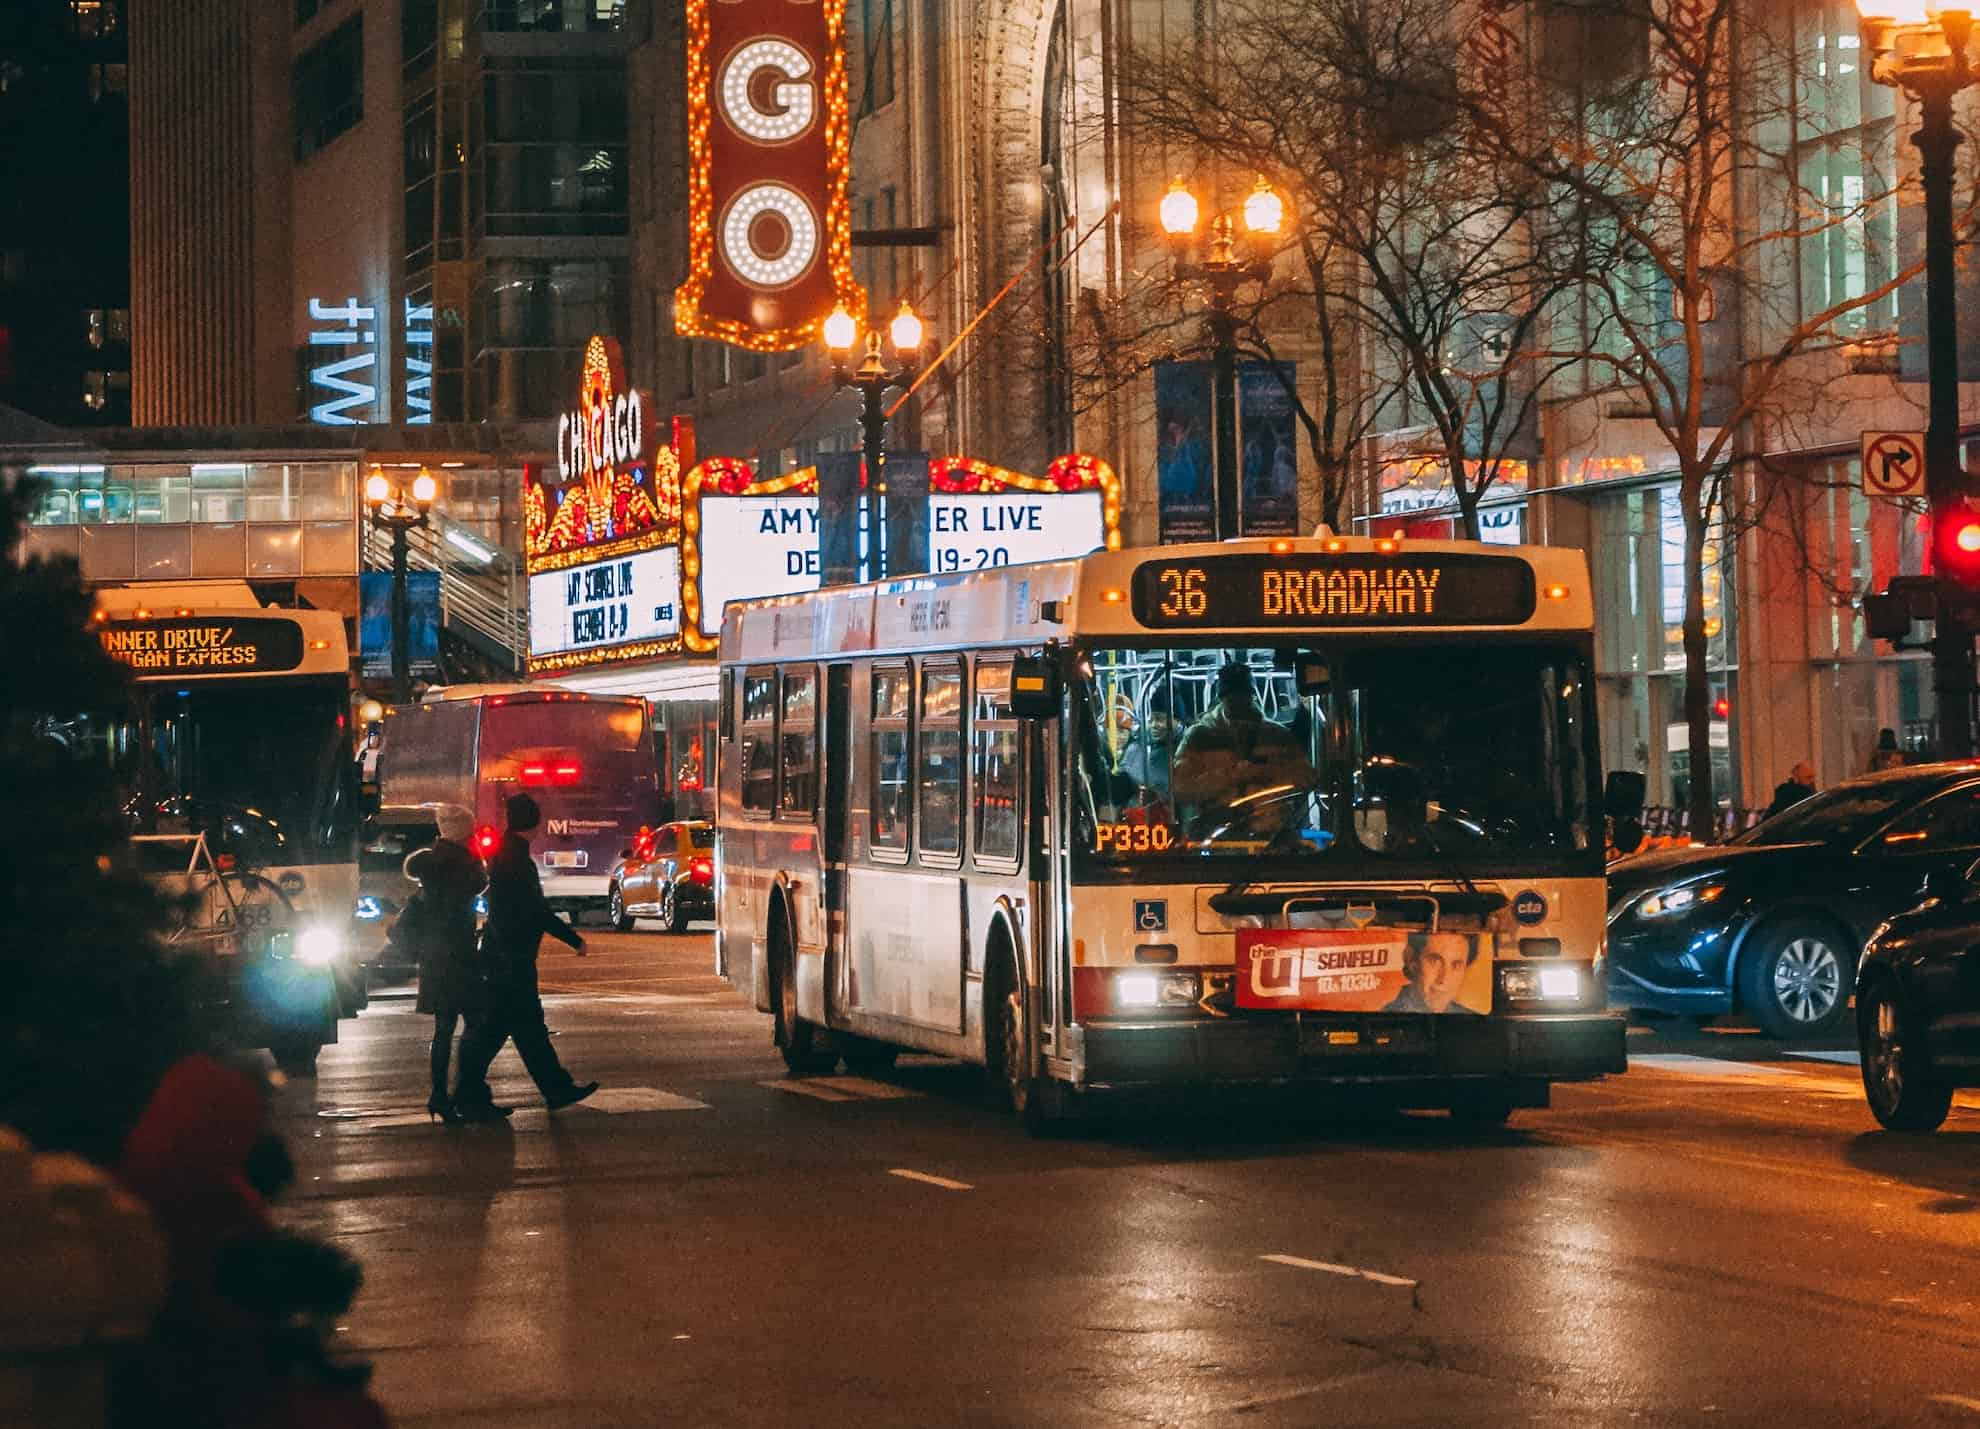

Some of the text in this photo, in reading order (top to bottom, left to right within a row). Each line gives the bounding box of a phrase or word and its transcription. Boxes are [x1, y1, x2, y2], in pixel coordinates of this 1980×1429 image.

[557, 388, 642, 482] CHICAGO
[759, 507, 820, 534] AMY
[982, 504, 1043, 532] LIVE
[937, 546, 1010, 573] 19-20
[1160, 568, 1441, 616] 36 BROADWAY
[103, 630, 159, 650] NNER
[175, 646, 257, 667] EXPRESS
[1095, 822, 1169, 852] P330
[1317, 948, 1389, 971] SEINFELD
